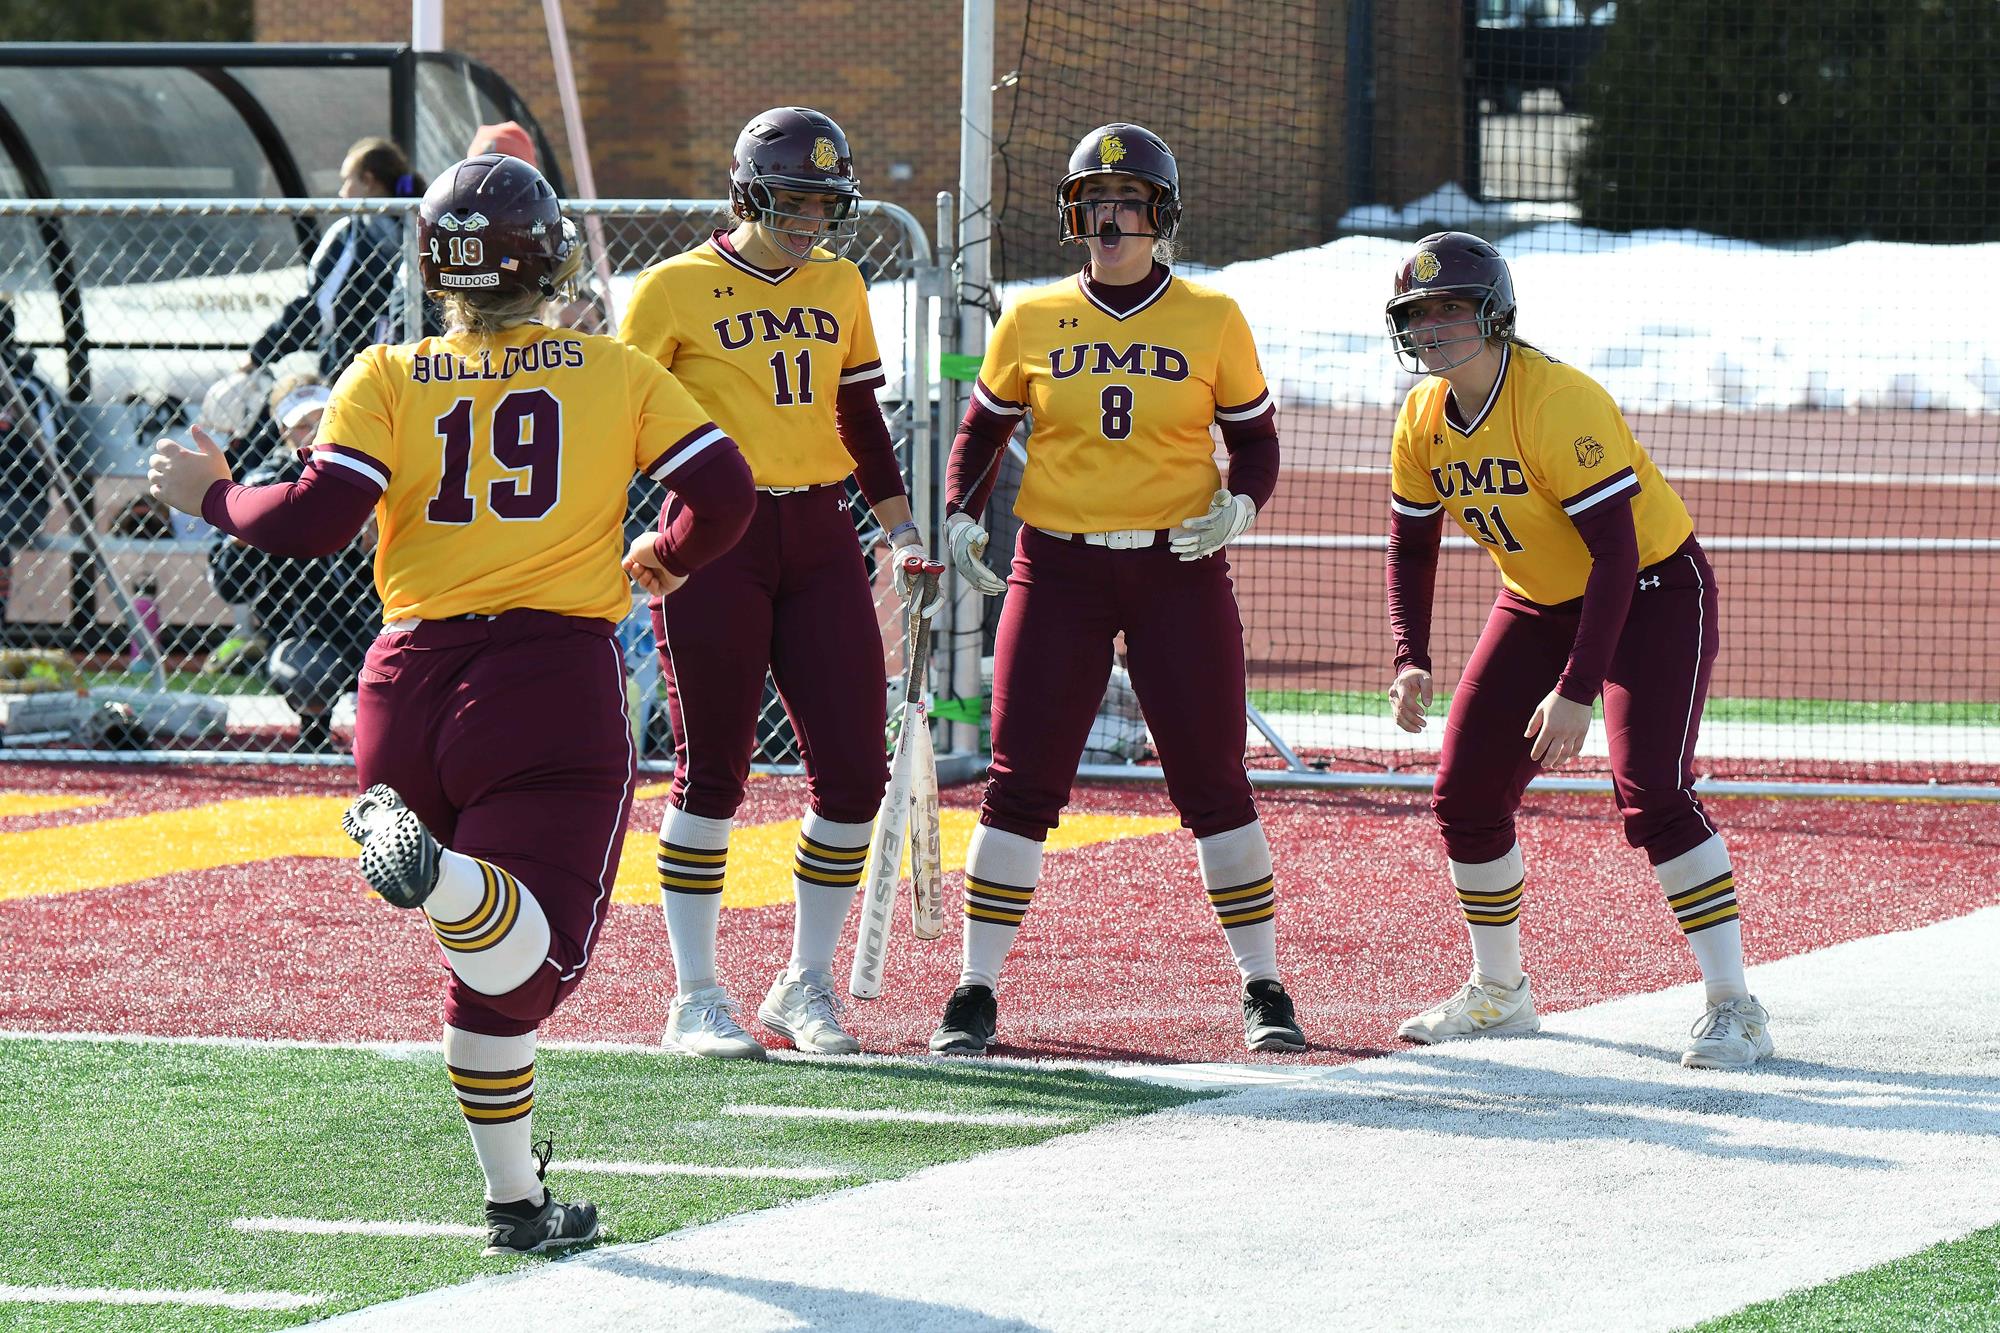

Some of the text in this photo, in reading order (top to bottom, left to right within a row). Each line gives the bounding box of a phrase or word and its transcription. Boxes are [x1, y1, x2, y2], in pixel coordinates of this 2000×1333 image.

[449, 237, 483, 265] 19
[441, 275, 498, 285] BULLDOGS
[713, 306, 841, 351] UMD
[412, 339, 584, 383] BULLDOGS
[768, 349, 814, 406] 11
[1048, 343, 1190, 382] UMD
[1099, 385, 1134, 441] 8
[426, 387, 562, 524] 19
[1430, 457, 1529, 500] UMD
[1463, 504, 1525, 554] 31
[926, 794, 943, 921] EASTON
[860, 828, 900, 983] EASTON
